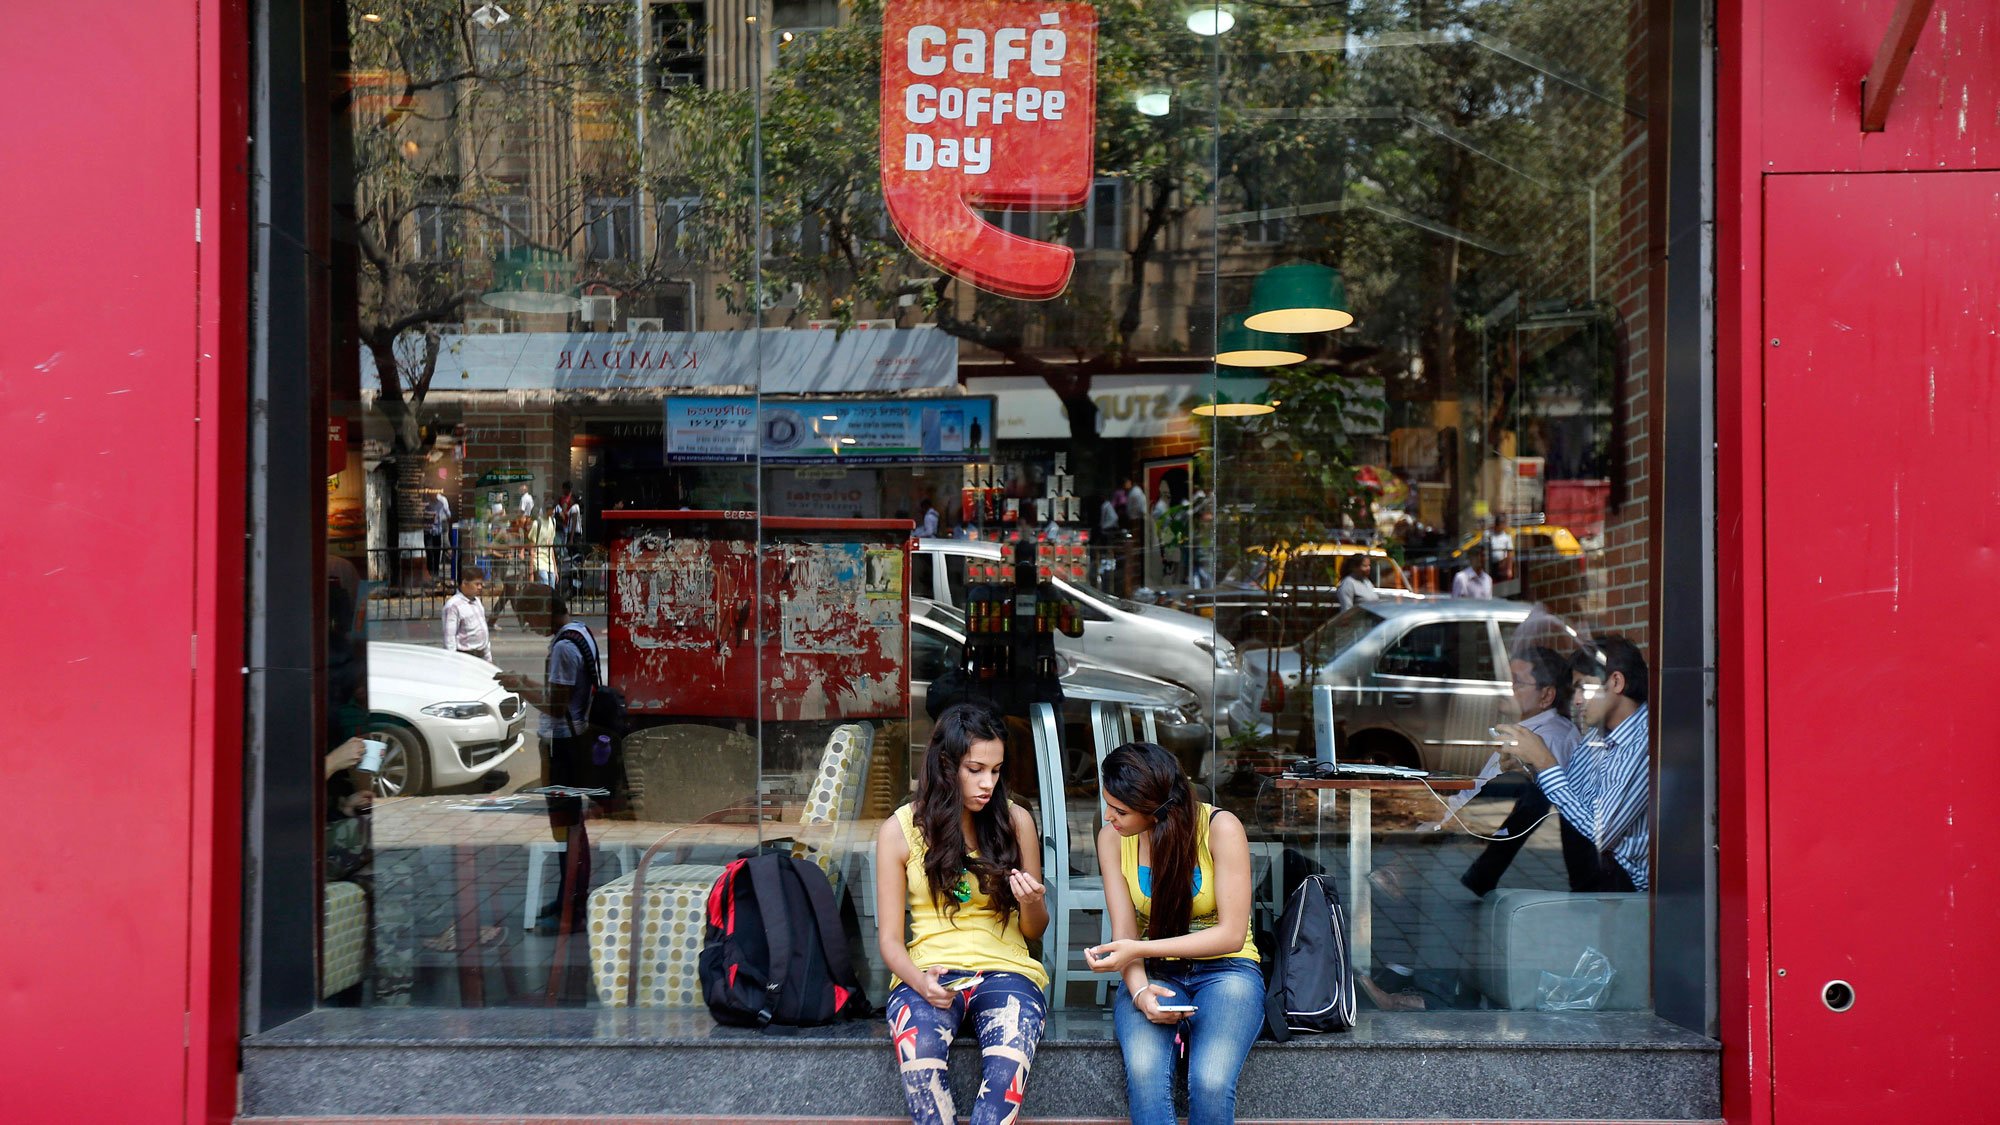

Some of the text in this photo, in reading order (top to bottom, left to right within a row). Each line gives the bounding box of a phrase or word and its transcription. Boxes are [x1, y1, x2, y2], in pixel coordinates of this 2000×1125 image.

[907, 12, 1067, 79] Café
[906, 83, 1066, 127] Coffee
[904, 133, 992, 175] Day
